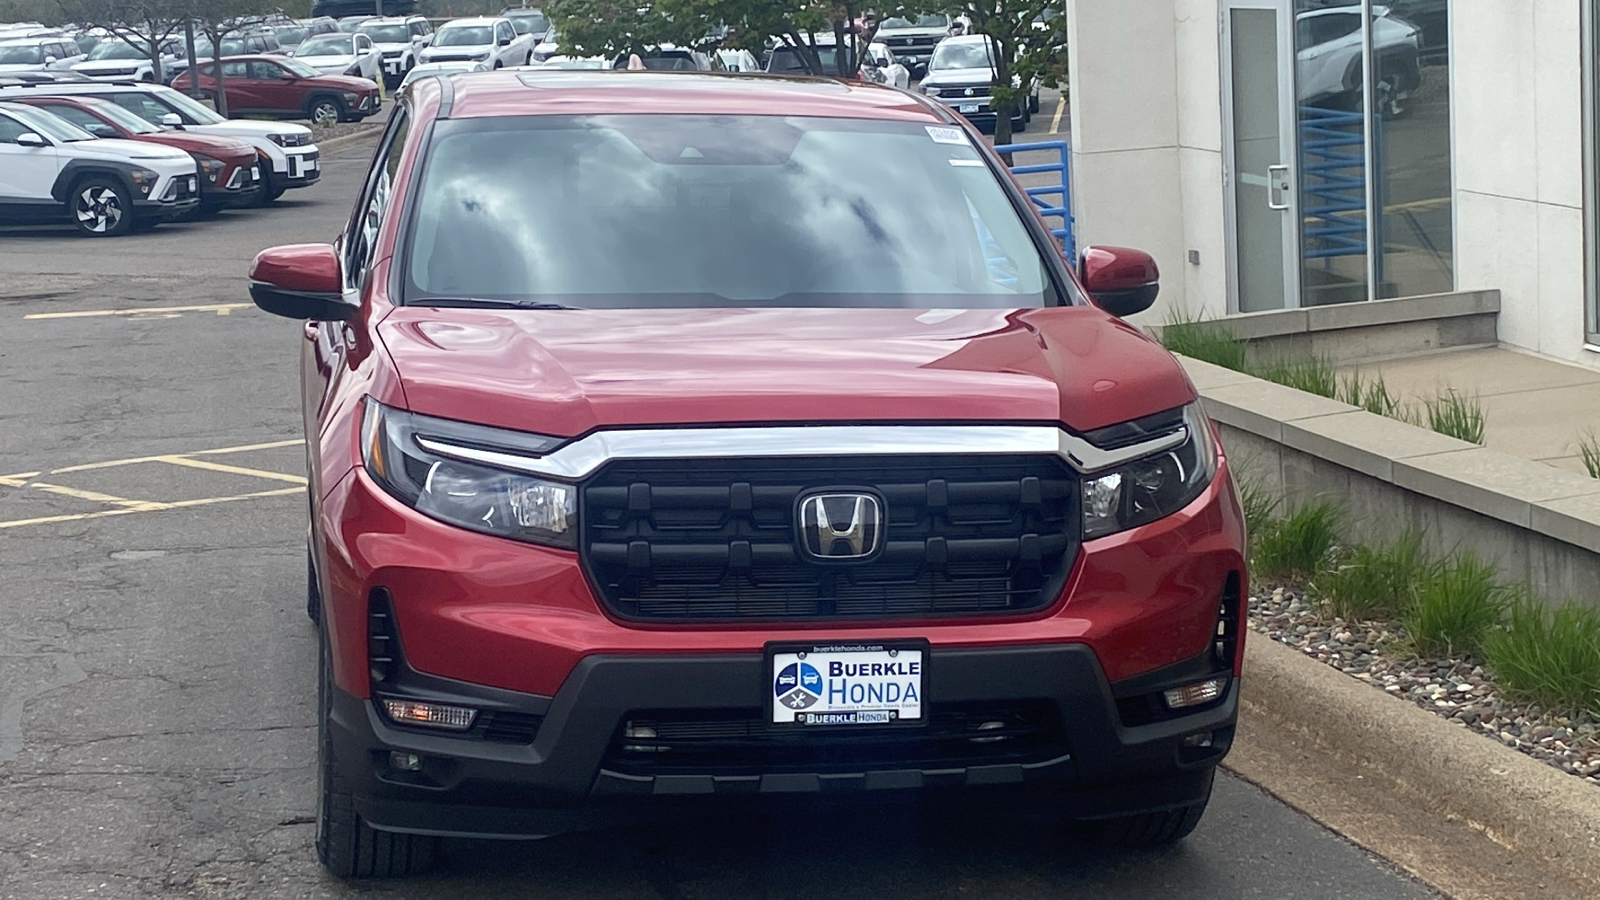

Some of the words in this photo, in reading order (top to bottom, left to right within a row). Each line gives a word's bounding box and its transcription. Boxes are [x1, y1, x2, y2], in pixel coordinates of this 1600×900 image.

[829, 661, 920, 677] BUERKLE
[828, 678, 919, 704] HONDA
[806, 713, 856, 723] BUERKLE
[858, 712, 888, 721] HONDA
